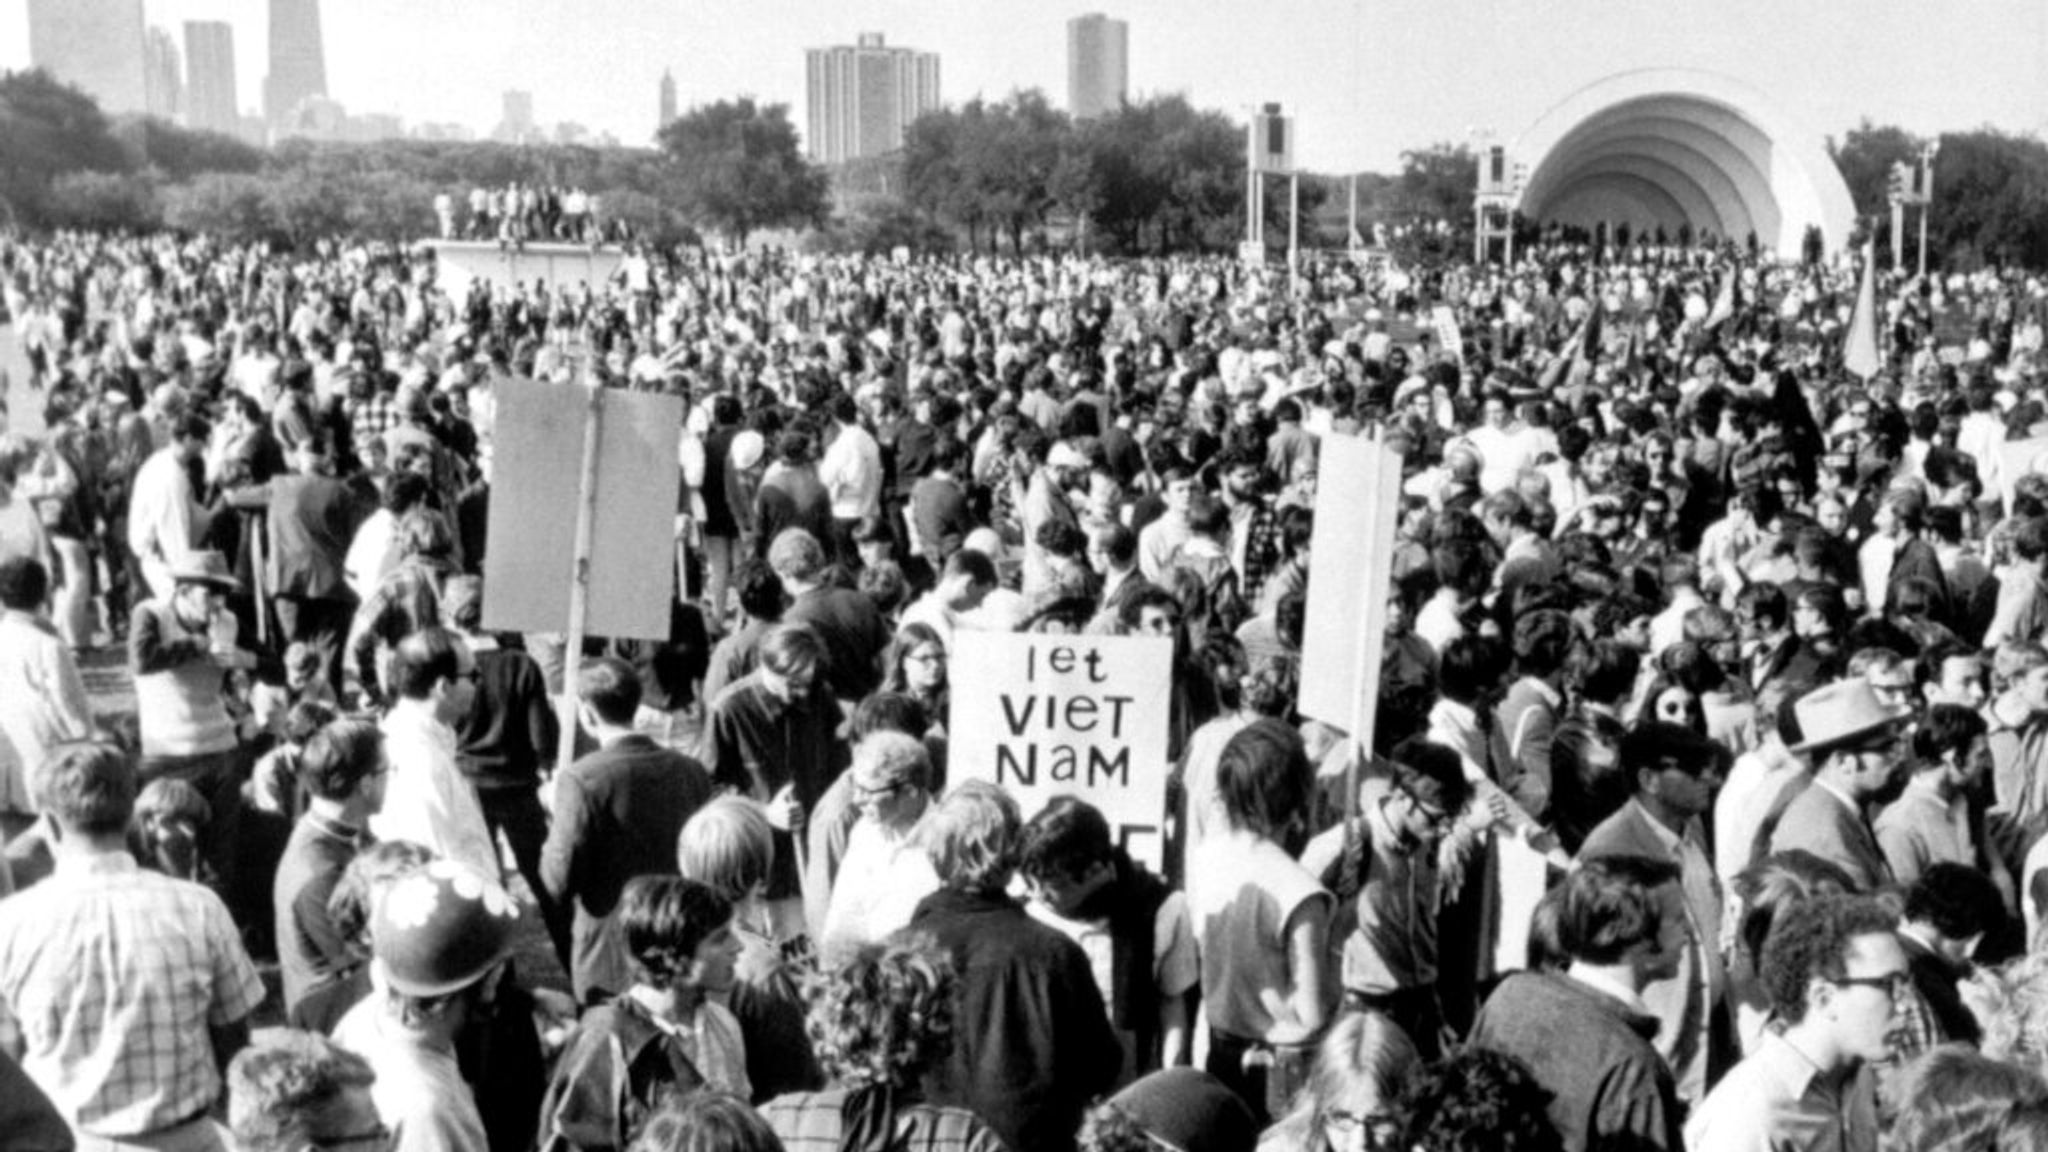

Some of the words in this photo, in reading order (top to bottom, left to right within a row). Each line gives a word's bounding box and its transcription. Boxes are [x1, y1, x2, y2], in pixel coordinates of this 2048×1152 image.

[1028, 645, 1107, 683] let
[1000, 694, 1134, 738] VIeT
[996, 743, 1130, 787] NaM
